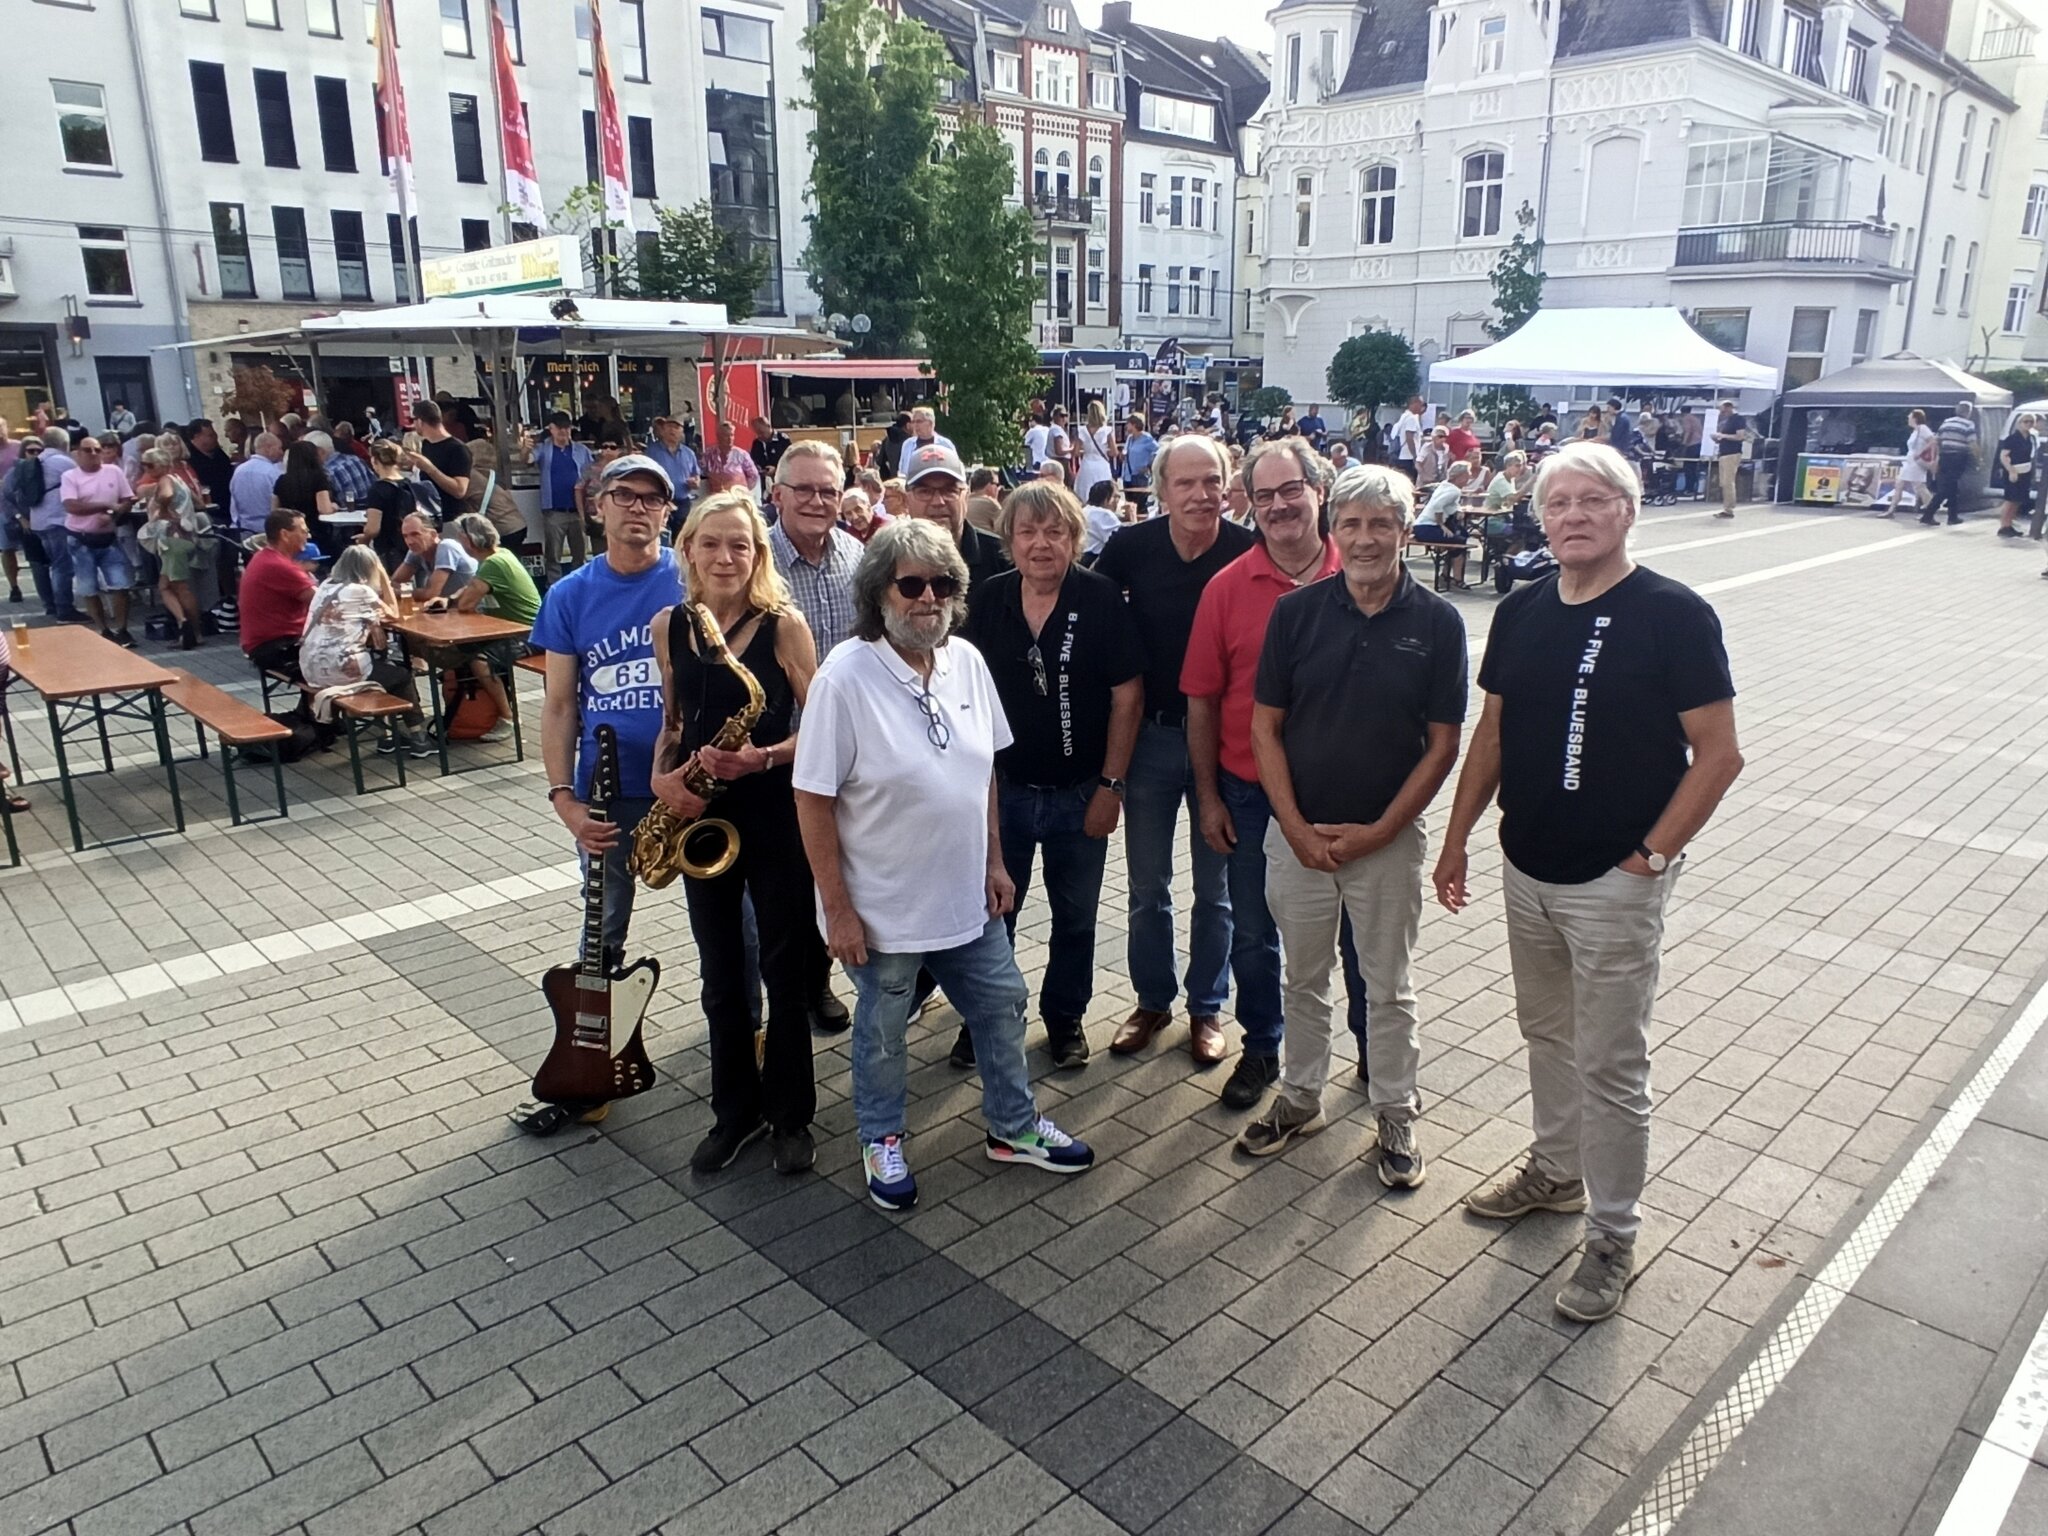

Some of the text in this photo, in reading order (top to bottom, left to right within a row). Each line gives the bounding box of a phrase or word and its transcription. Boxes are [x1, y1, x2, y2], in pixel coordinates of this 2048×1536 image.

[547, 361, 600, 373] Merznich
[1059, 632, 1074, 662] FIVE
[1578, 639, 1603, 674] FIVE
[615, 661, 650, 688] 63
[1059, 674, 1073, 756] BLUESBAND
[1563, 688, 1588, 791] BLUESBAND
